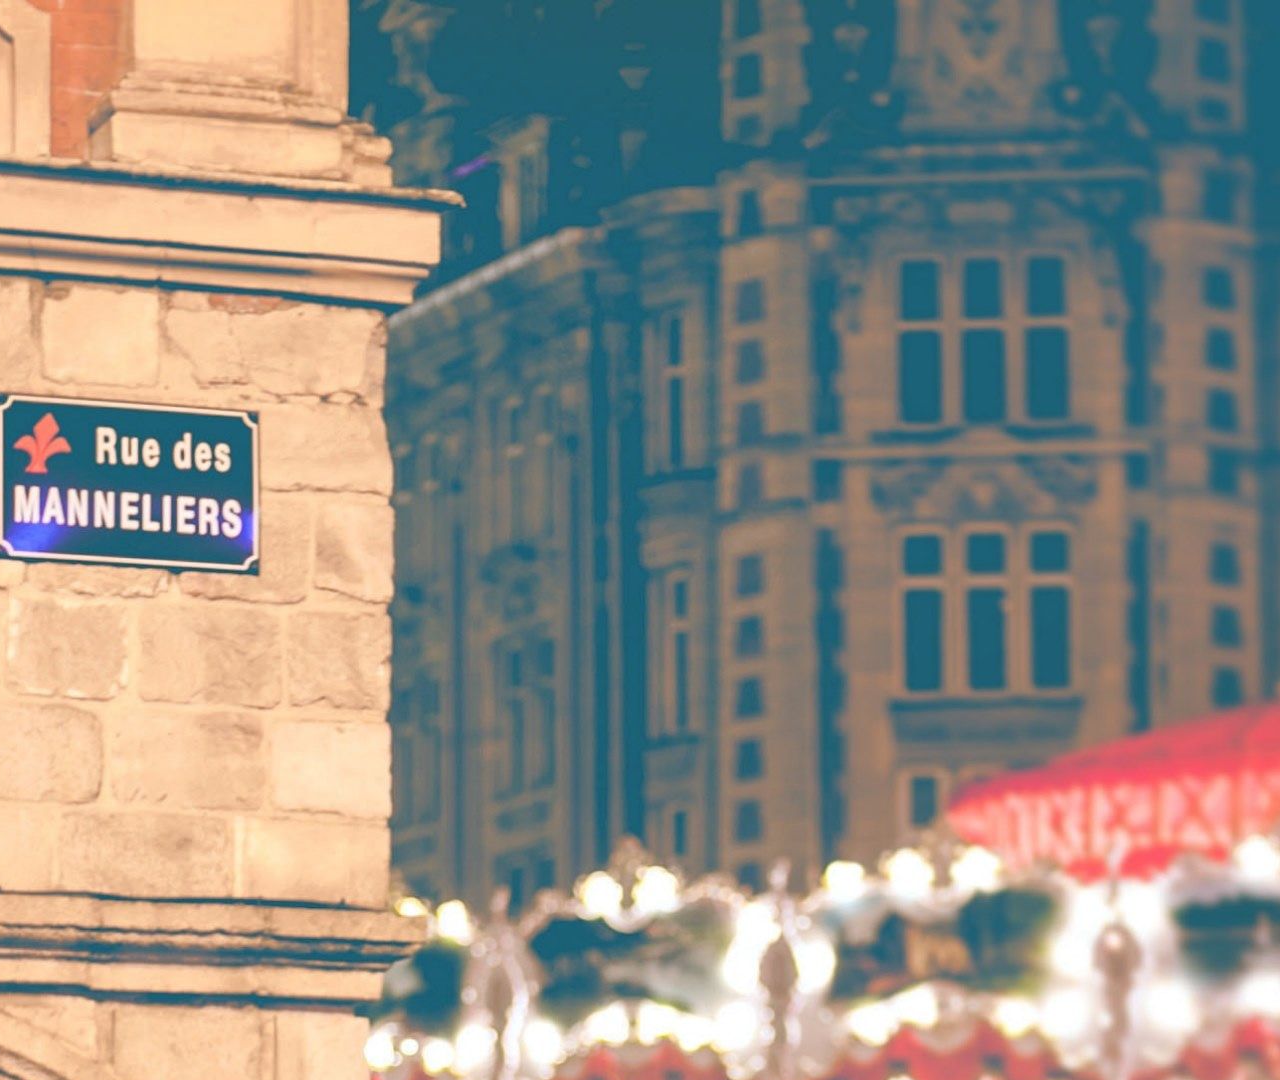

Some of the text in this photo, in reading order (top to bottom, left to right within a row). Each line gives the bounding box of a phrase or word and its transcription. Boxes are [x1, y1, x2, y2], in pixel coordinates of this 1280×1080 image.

[95, 426, 232, 473] Rue des
[13, 484, 243, 539] MANNELIERS
